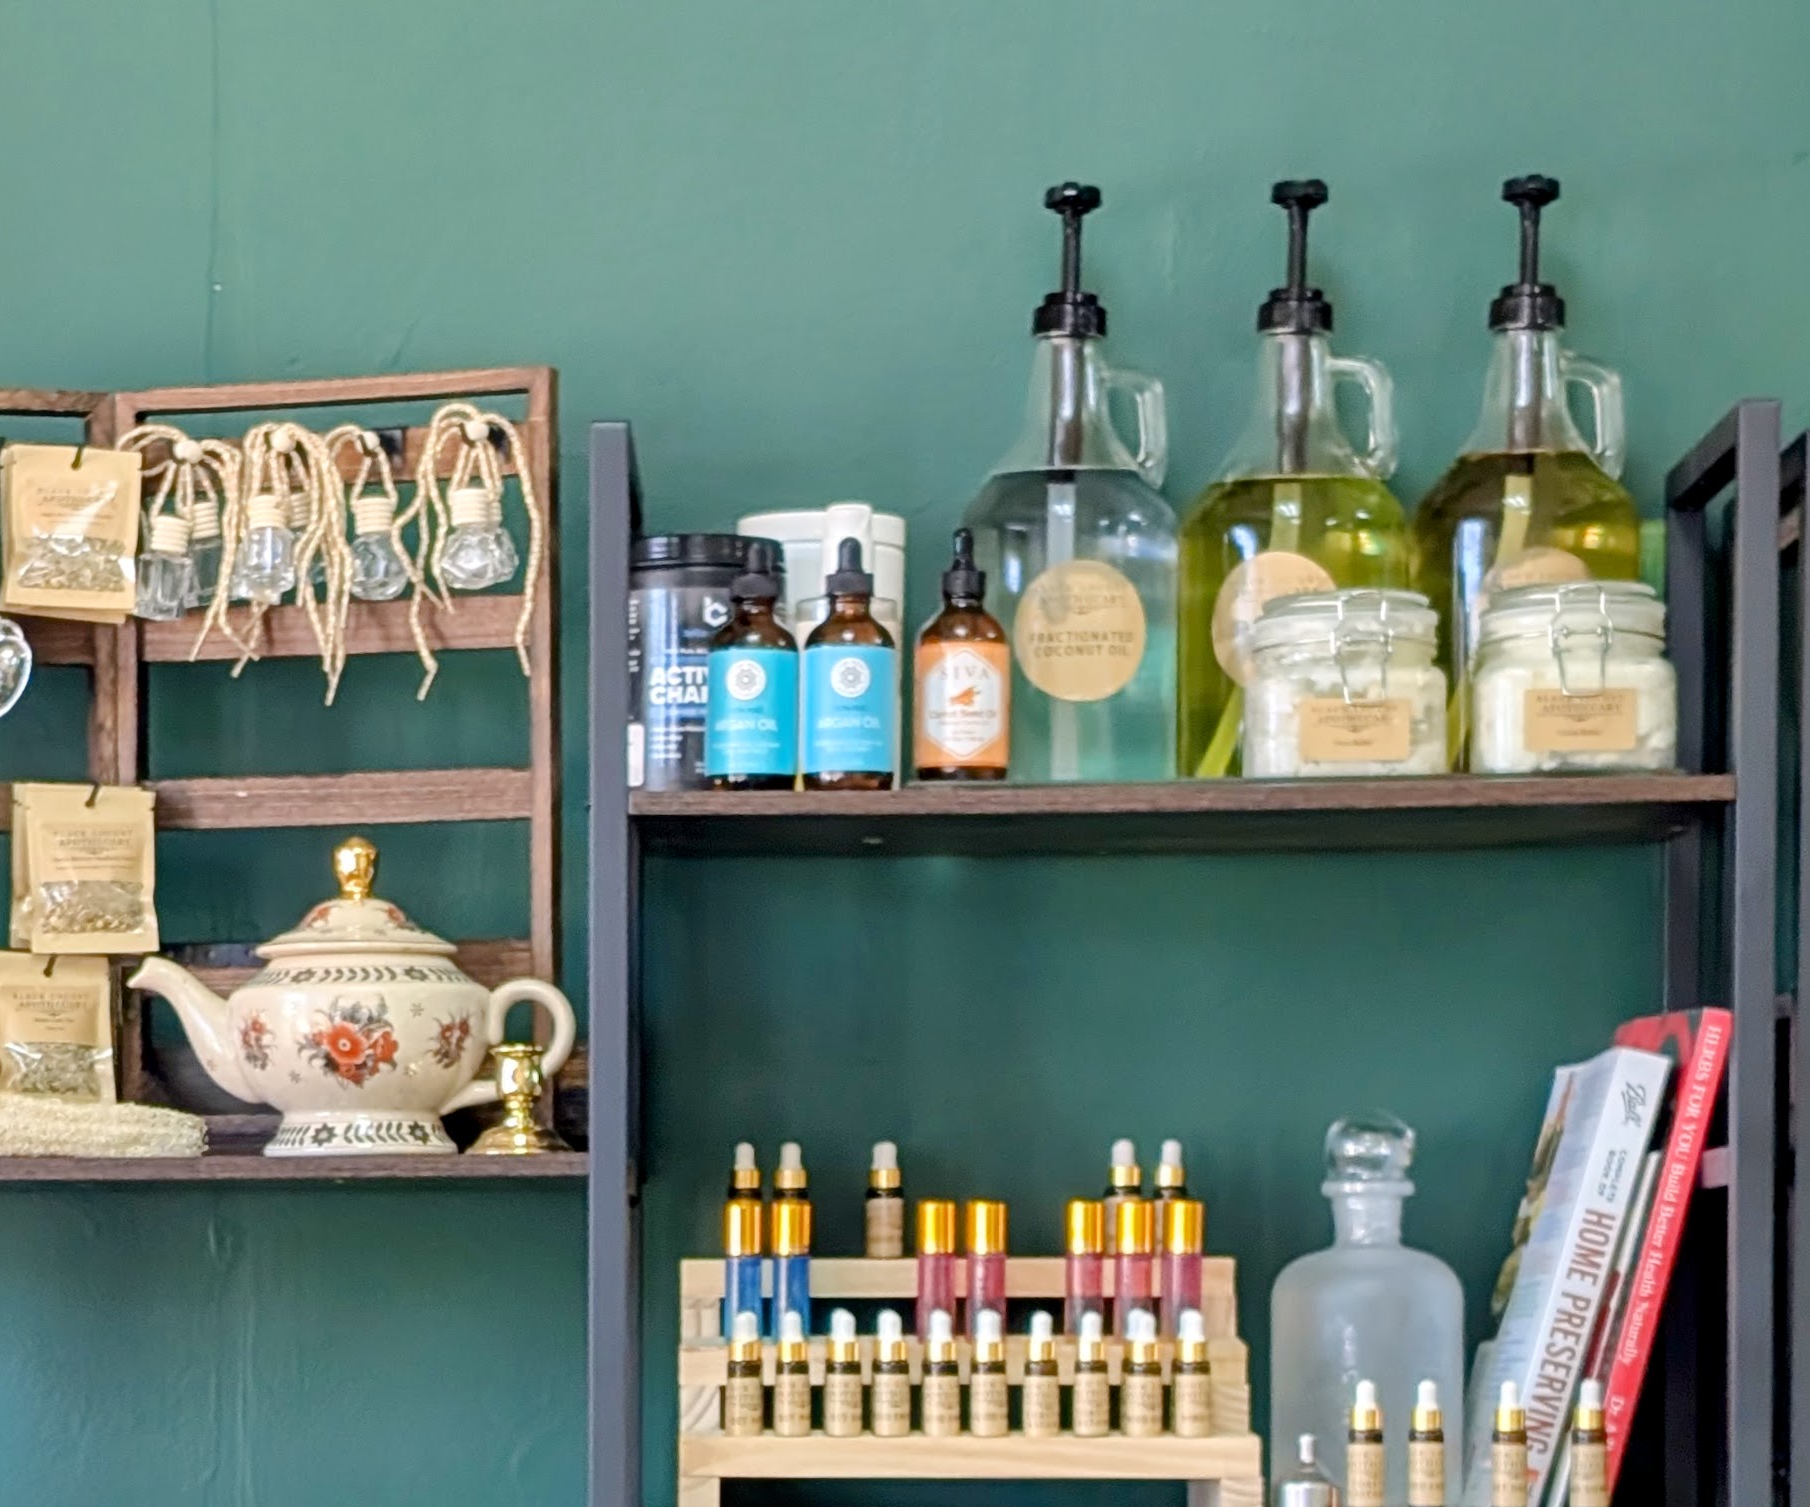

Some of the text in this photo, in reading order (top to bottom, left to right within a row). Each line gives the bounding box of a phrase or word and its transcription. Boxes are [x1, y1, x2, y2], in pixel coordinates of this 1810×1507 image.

[1030, 630, 1134, 643] FRACTIONATED
[1033, 644, 1129, 658] COCONUT OIL
[1618, 1024, 1722, 1366] HERBS FOR YOU Build Better Health Naturally
[1527, 1207, 1616, 1456] HOME PRESERVING
